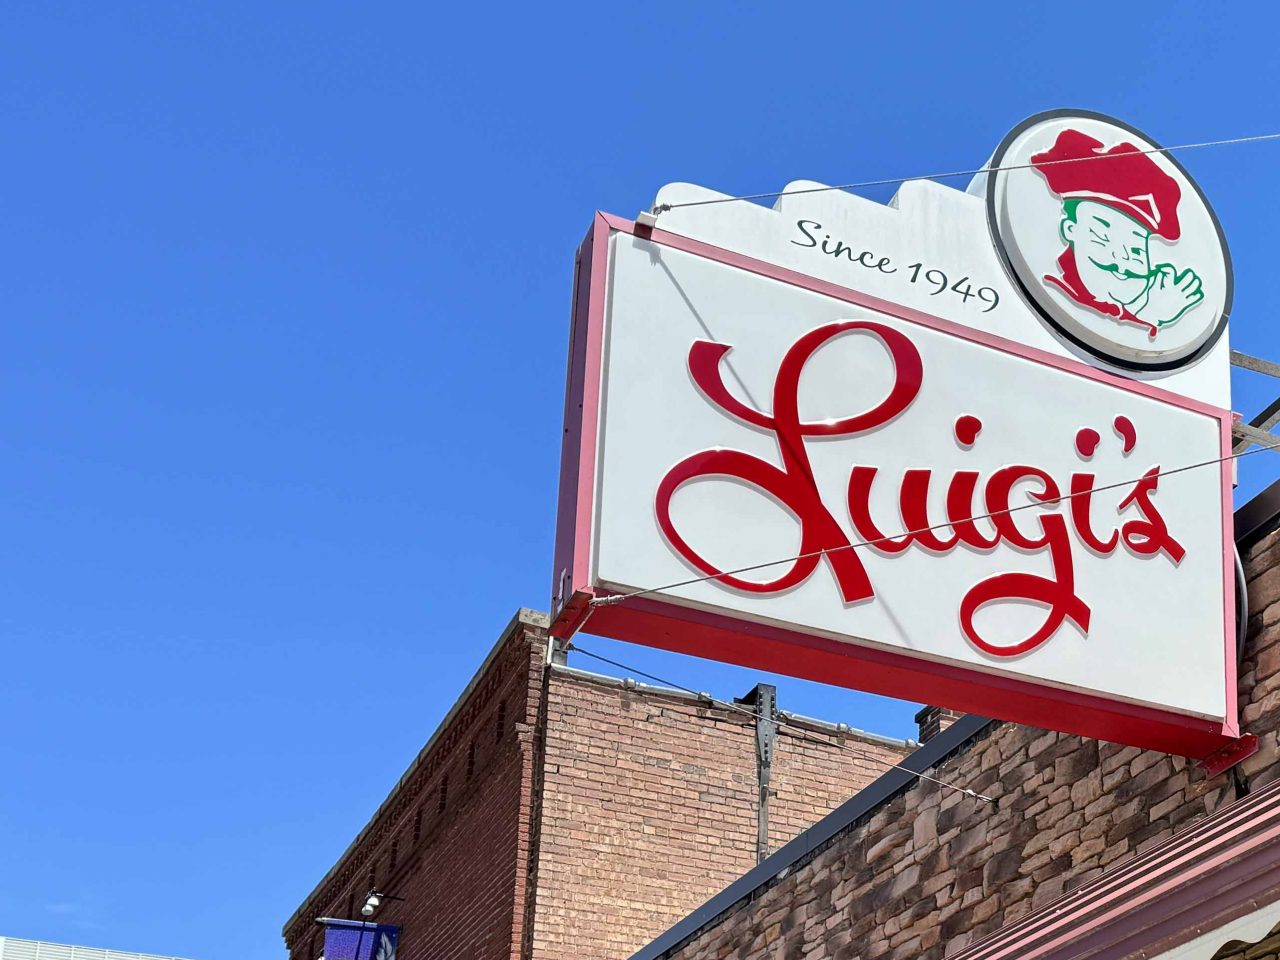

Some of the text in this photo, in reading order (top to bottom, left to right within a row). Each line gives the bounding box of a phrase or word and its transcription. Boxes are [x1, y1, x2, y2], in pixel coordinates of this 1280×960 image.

[790, 219, 1000, 313] Since 1949
[655, 320, 1186, 657] Luigi's
